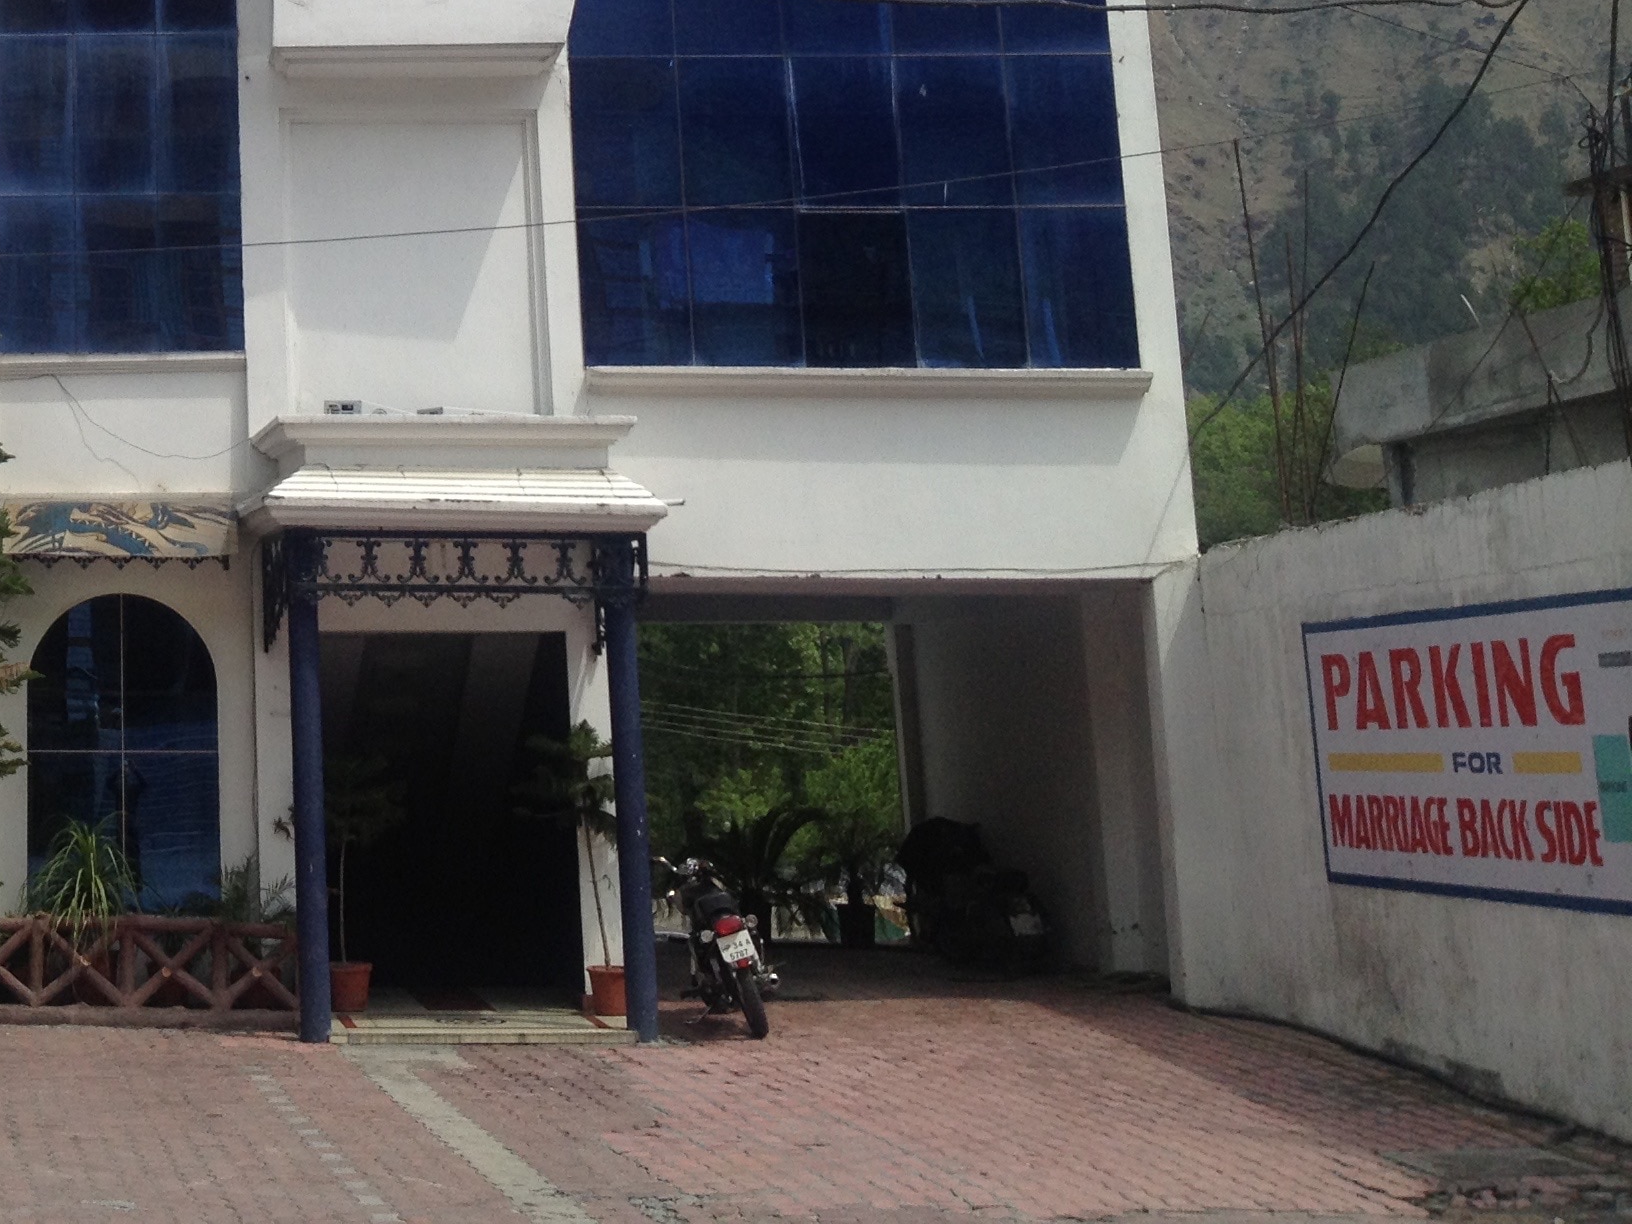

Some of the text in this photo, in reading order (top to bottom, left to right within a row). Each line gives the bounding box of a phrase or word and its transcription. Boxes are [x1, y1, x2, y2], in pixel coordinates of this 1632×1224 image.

[1321, 634, 1585, 730] PARKING
[1452, 752, 1503, 774] FOR
[1329, 794, 1604, 866] MARRIAGE BACK SIDE
